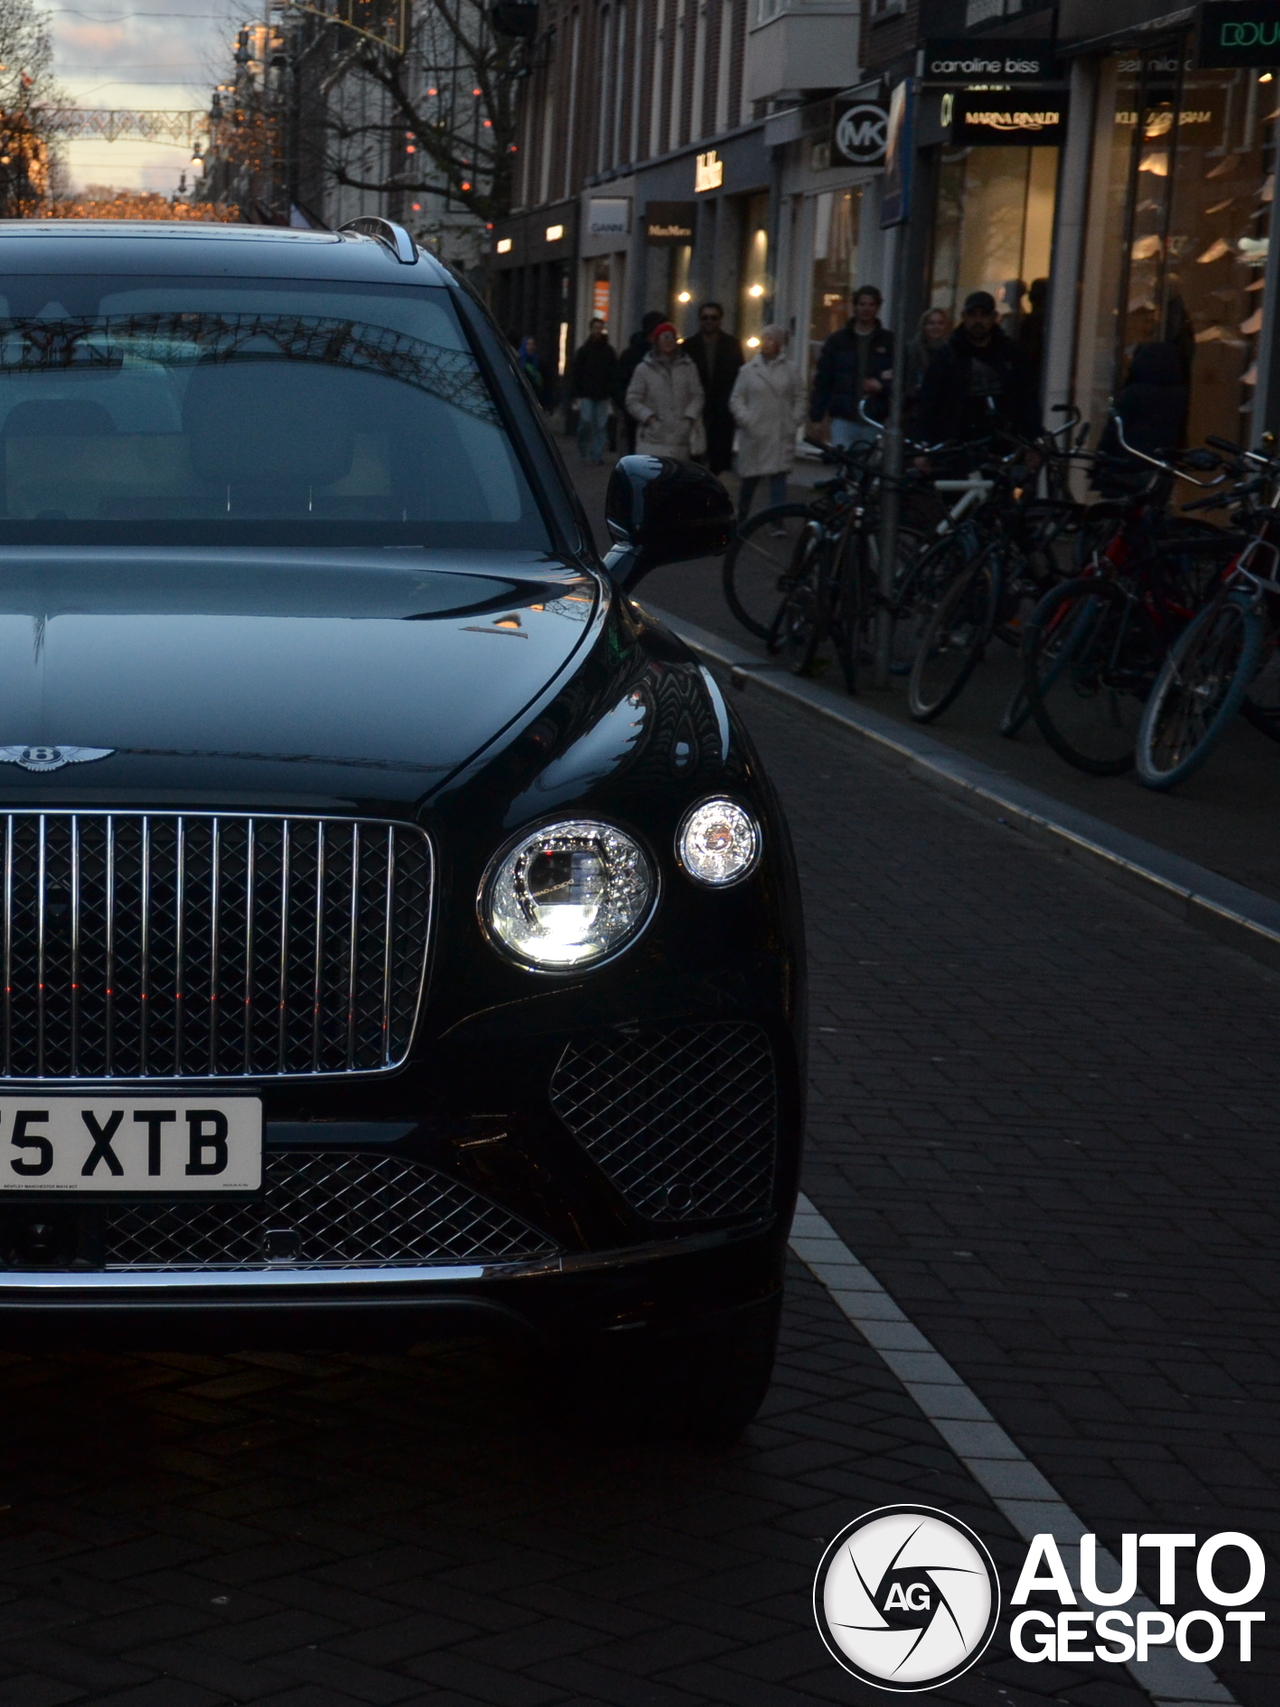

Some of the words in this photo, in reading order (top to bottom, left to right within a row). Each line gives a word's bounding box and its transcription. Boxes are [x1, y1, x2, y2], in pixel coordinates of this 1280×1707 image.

[1221, 21, 1280, 46] DOU
[930, 57, 1002, 73] caroline
[1004, 57, 1040, 73] biss
[81, 1109, 228, 1176] XTB
